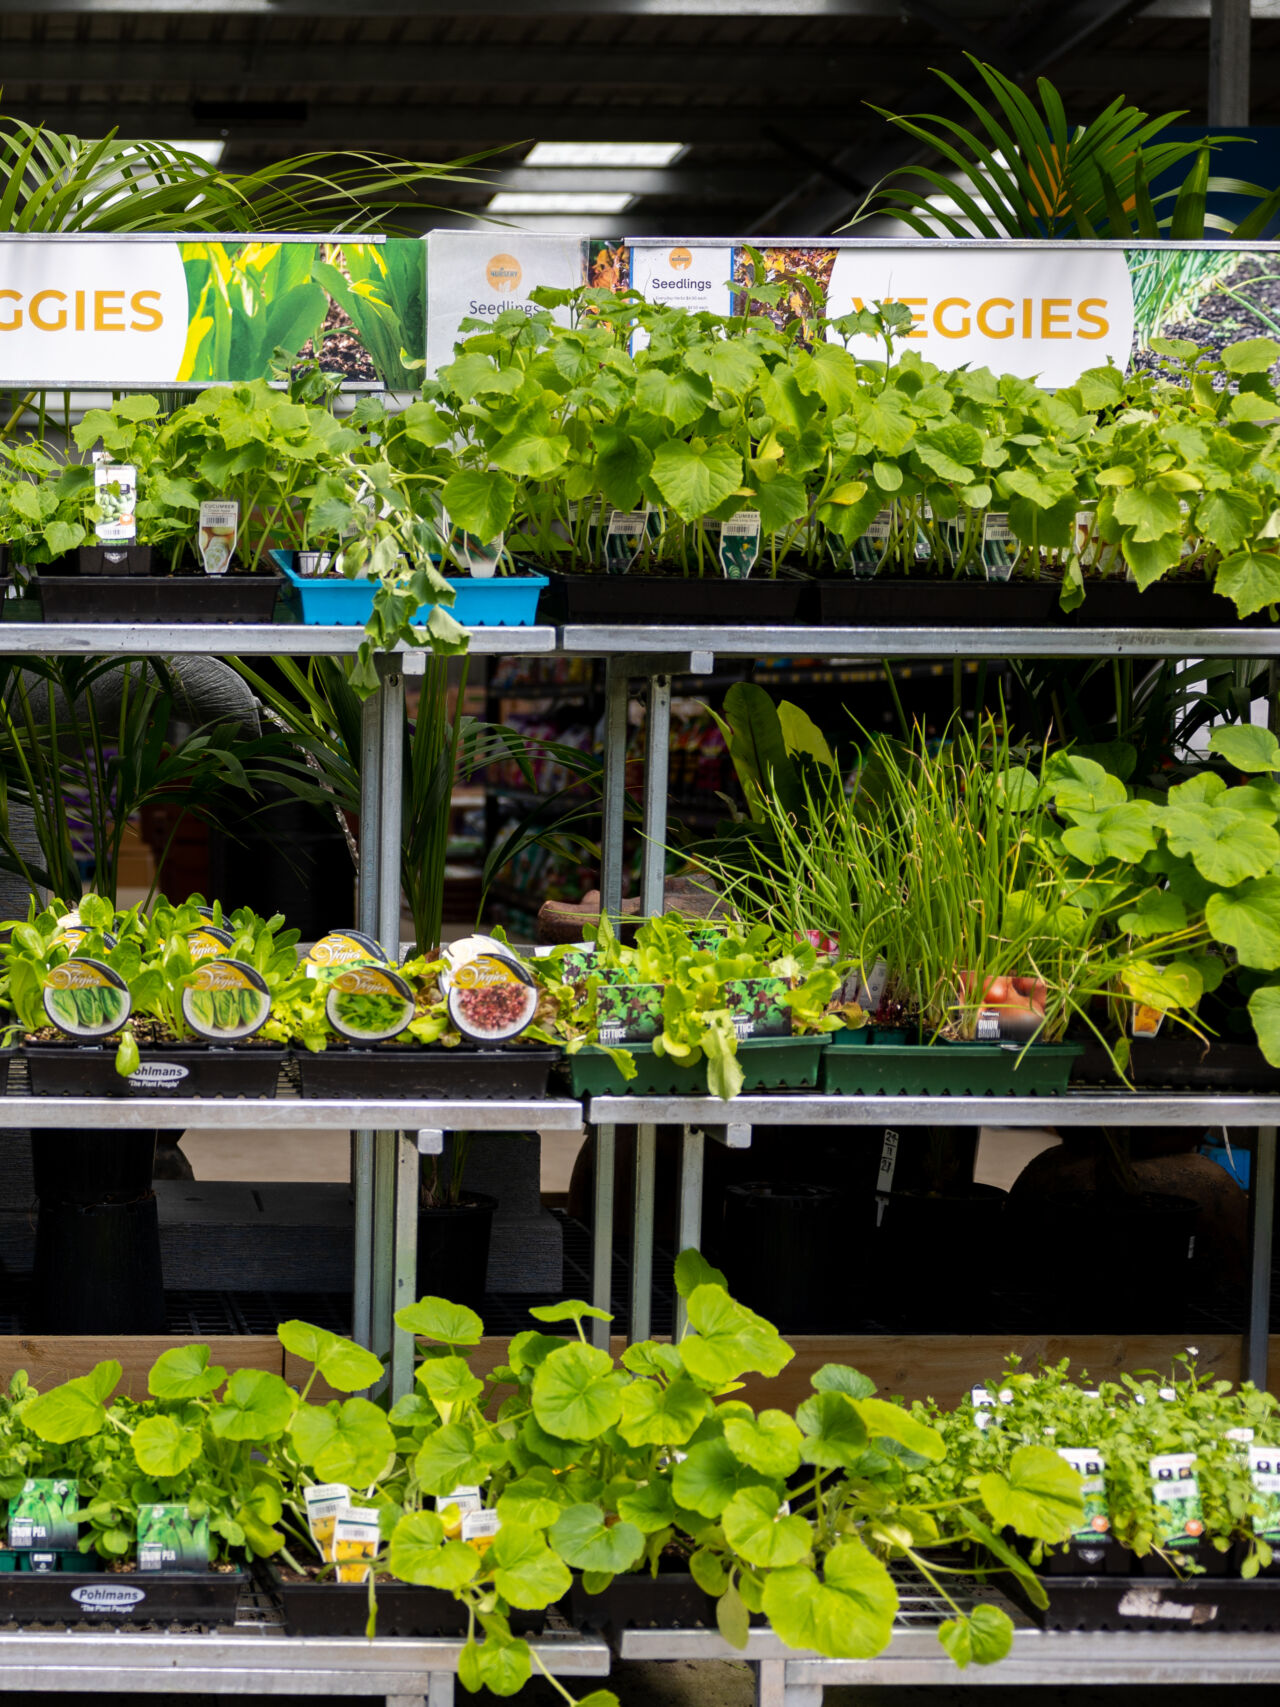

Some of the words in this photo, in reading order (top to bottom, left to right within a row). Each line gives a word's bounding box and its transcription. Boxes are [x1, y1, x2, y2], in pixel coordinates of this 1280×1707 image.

[652, 278, 712, 291] Seedlings
[600, 1028, 626, 1039] LETTUCE
[133, 1066, 183, 1077] ohlmans
[11, 1526, 33, 1537] SNOW
[33, 1526, 46, 1537] PEA
[140, 1551, 162, 1561] SNOW
[162, 1550, 176, 1561] PEA
[79, 1589, 139, 1600] Pohlmans
